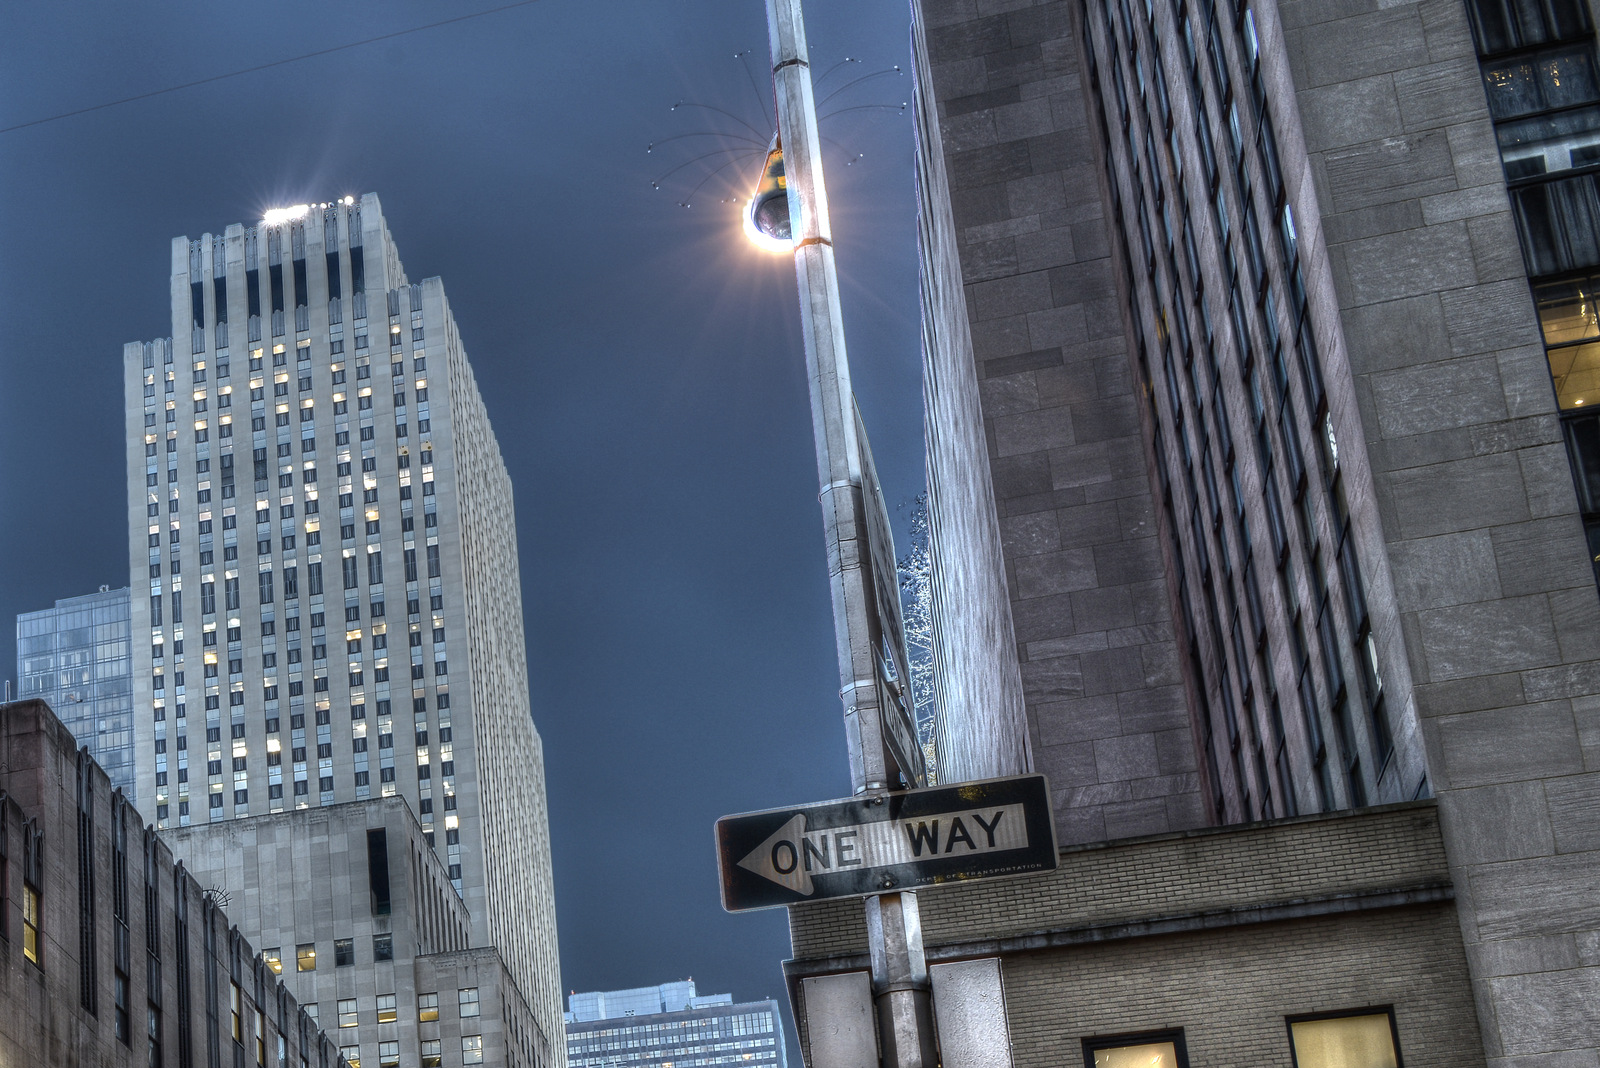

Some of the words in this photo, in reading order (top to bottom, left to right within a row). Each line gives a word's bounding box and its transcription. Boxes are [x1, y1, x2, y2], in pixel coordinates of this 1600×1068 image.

[771, 830, 861, 874] ONE
[905, 811, 1004, 857] WAY
[966, 864, 1042, 876] TRANSPORTATION
